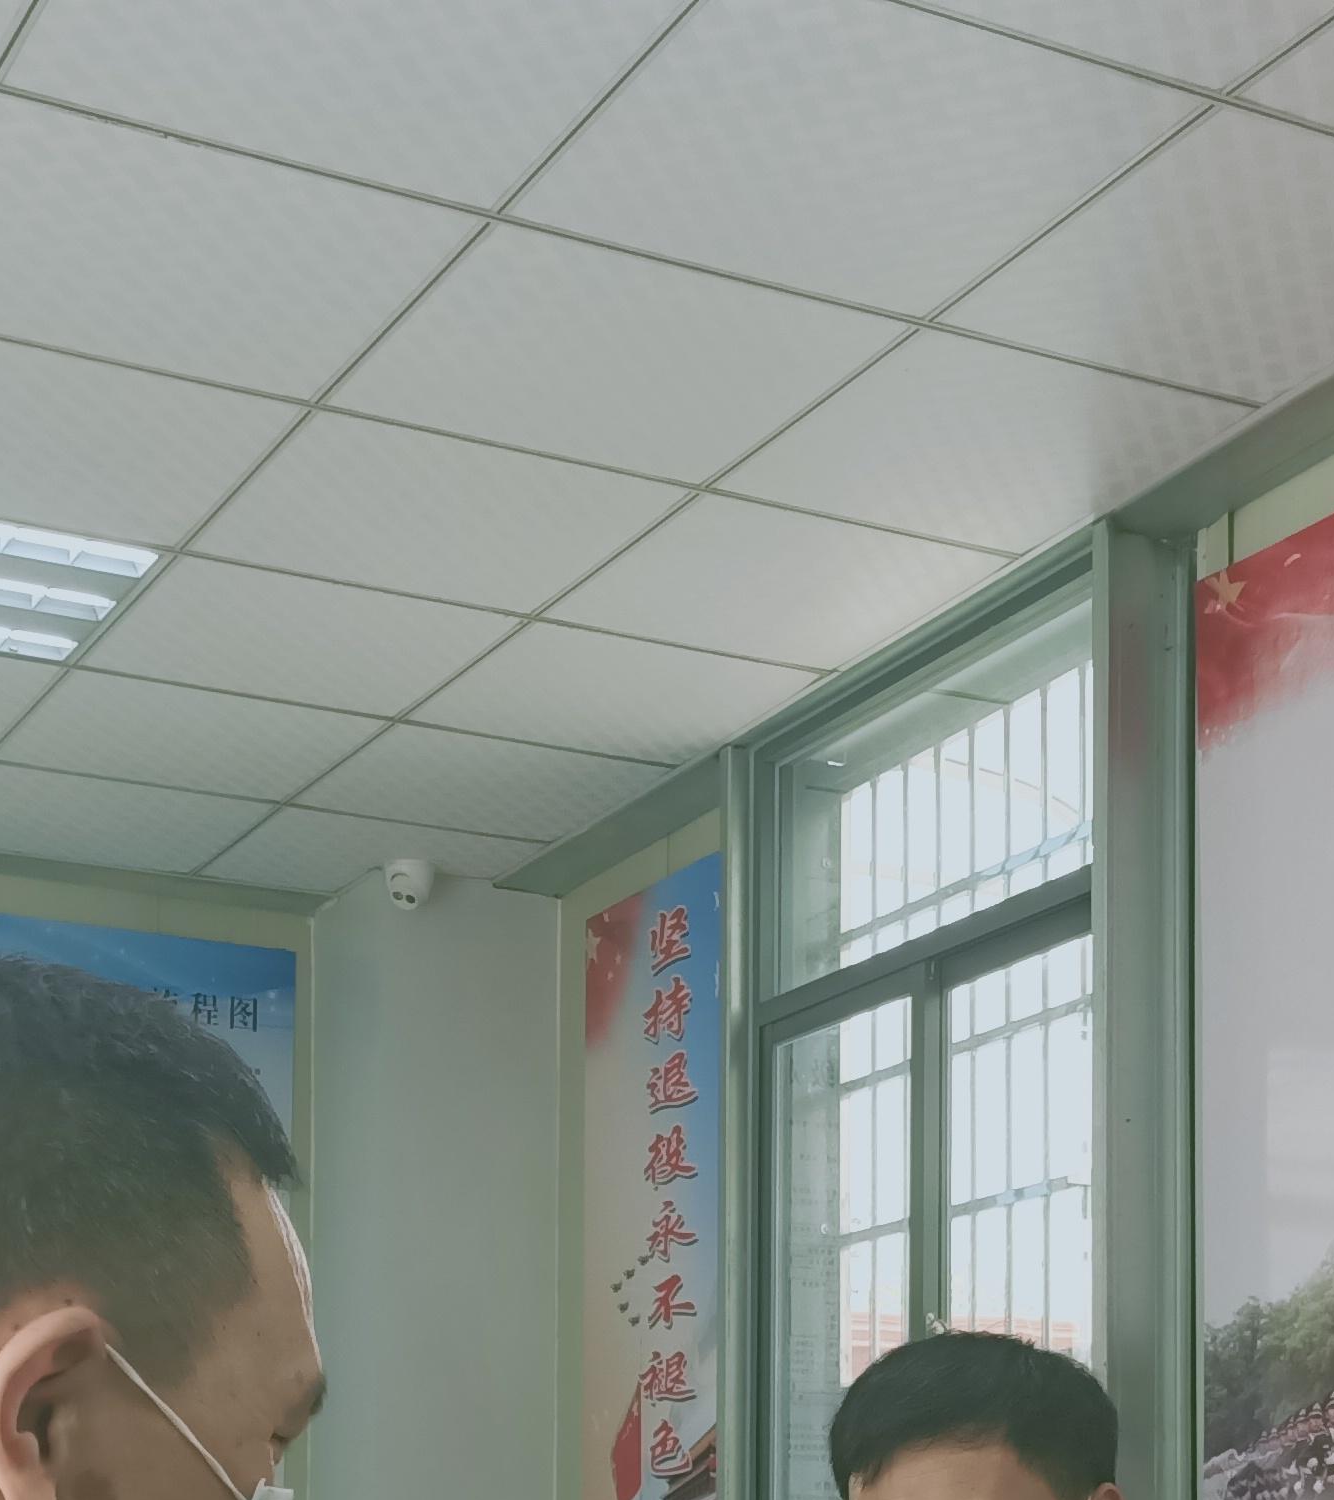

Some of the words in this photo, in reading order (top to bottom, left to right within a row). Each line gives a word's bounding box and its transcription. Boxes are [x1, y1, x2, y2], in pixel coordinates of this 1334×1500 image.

[153, 987, 258, 1033] 程图
[639, 905, 698, 1478] 坚持退役永不褪色
